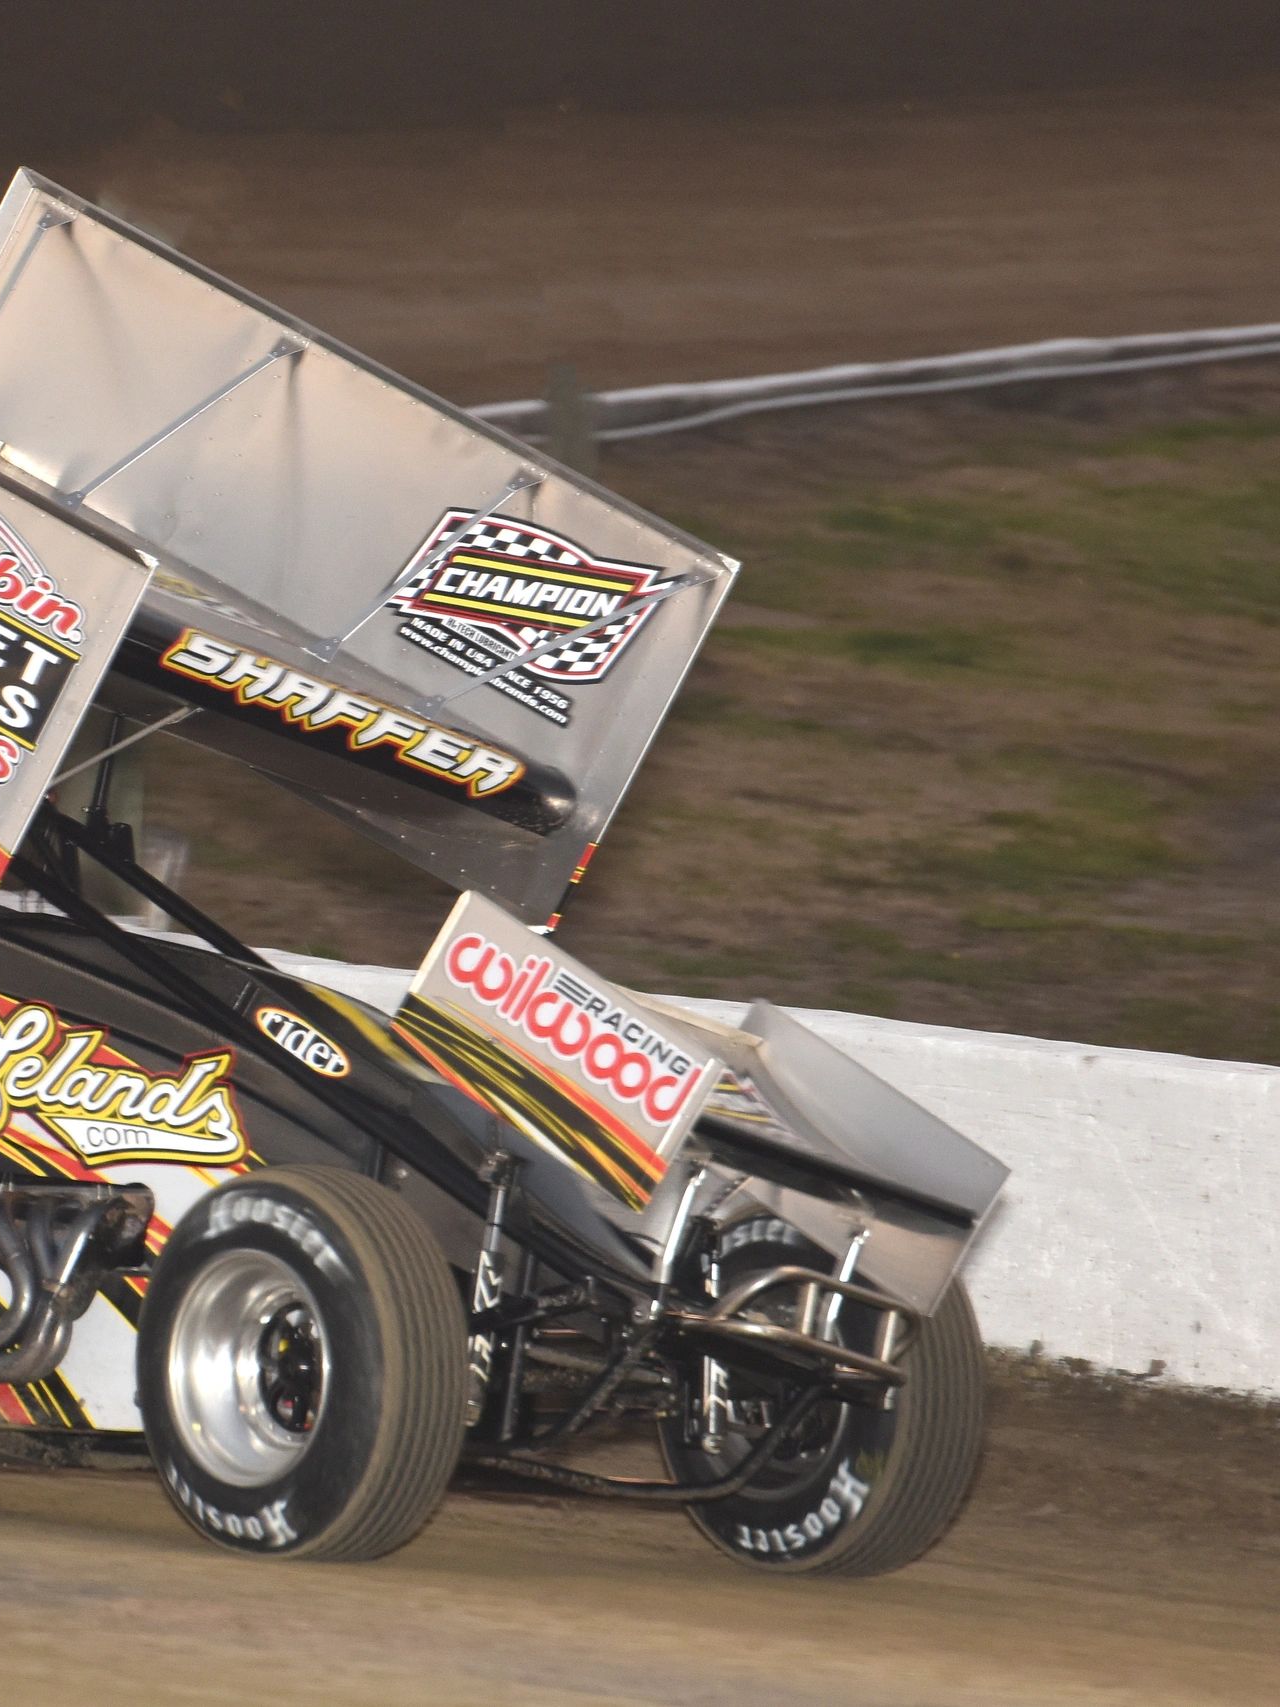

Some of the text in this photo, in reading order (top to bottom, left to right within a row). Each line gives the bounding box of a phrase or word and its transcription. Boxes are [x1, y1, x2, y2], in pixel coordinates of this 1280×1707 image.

[432, 567, 624, 617] CHAMPION
[399, 626, 568, 724] www.champibrands.com
[410, 617, 569, 709] MADE IN USA NCE 1956
[475, 631, 518, 661] LUBRICANT
[166, 629, 520, 795] SHAFFER
[447, 936, 703, 1123] wilwood
[584, 991, 690, 1075] RACING
[737, 1458, 870, 1553] Hoosier
